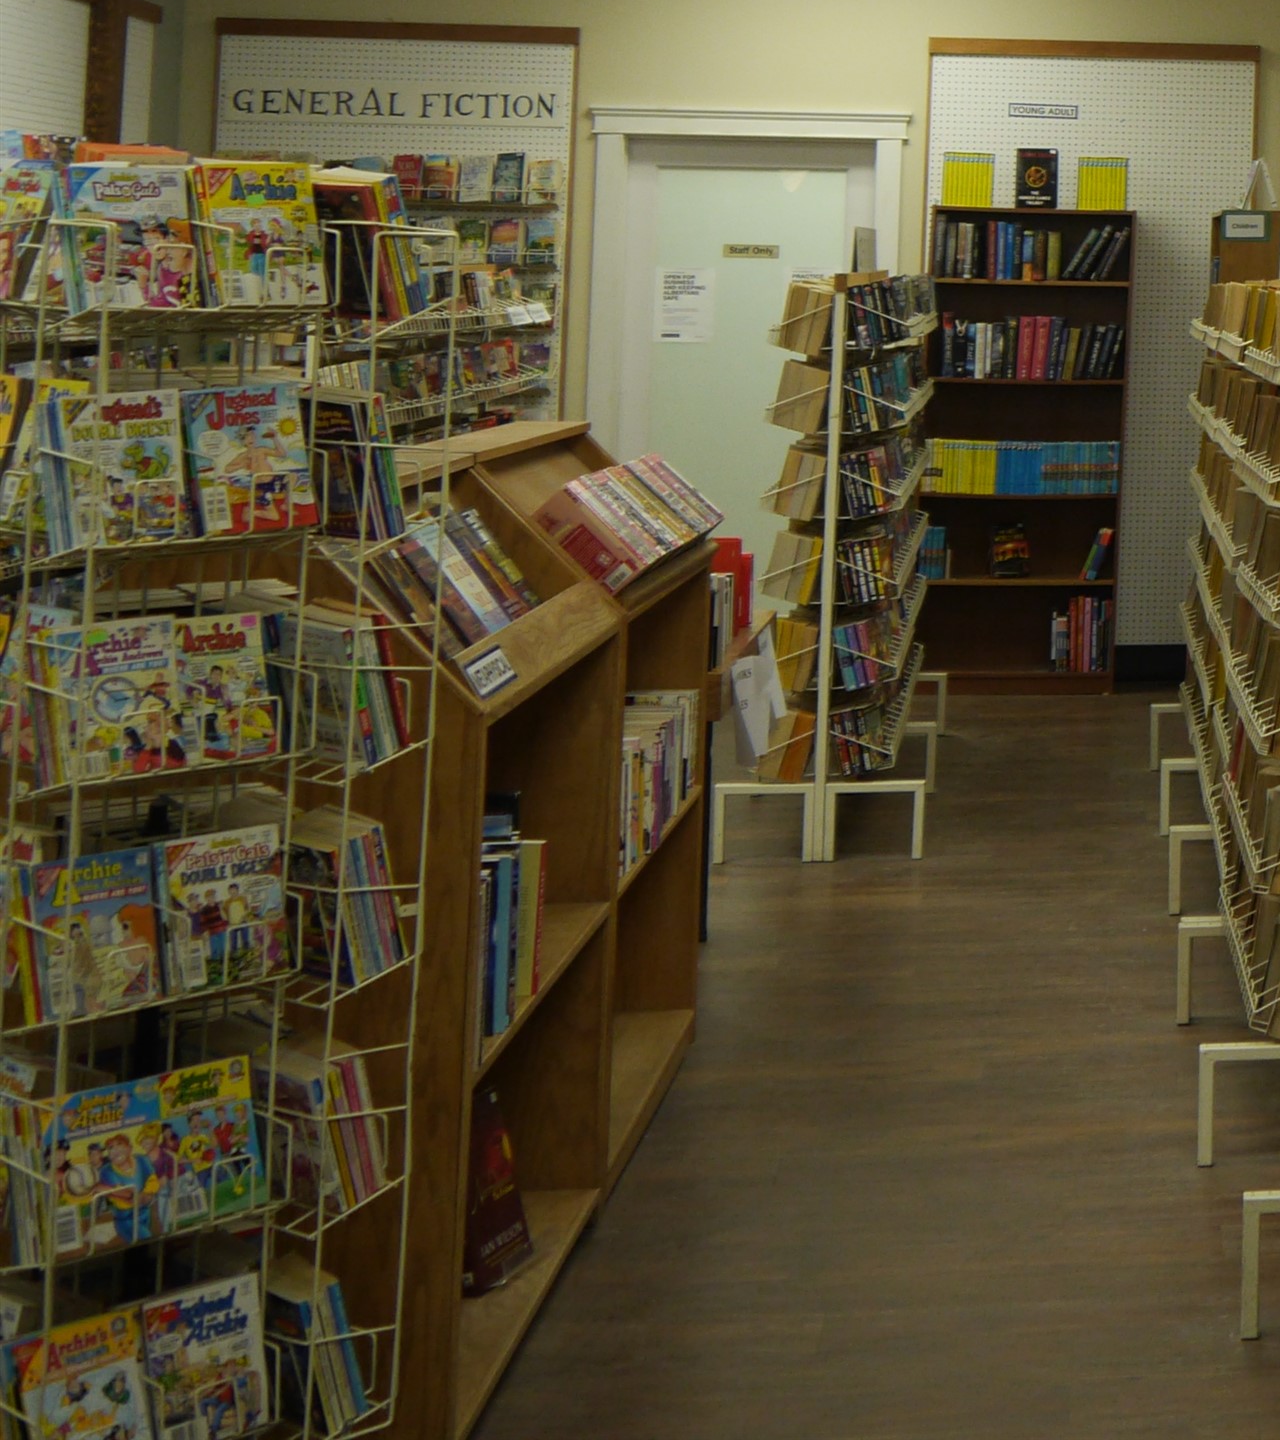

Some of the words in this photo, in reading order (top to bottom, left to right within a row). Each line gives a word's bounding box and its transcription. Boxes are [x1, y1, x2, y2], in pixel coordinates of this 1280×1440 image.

[232, 88, 405, 117] GENERAL
[420, 92, 556, 119] FICTION
[1012, 106, 1046, 115] YOUNG
[1048, 108, 1075, 117] ADULT
[1231, 221, 1258, 231] Children
[729, 246, 749, 255] Staff
[752, 247, 774, 256] Only
[126, 418, 174, 438] DIGEST
[183, 622, 247, 652] Archie
[180, 863, 227, 884] DOUBLE
